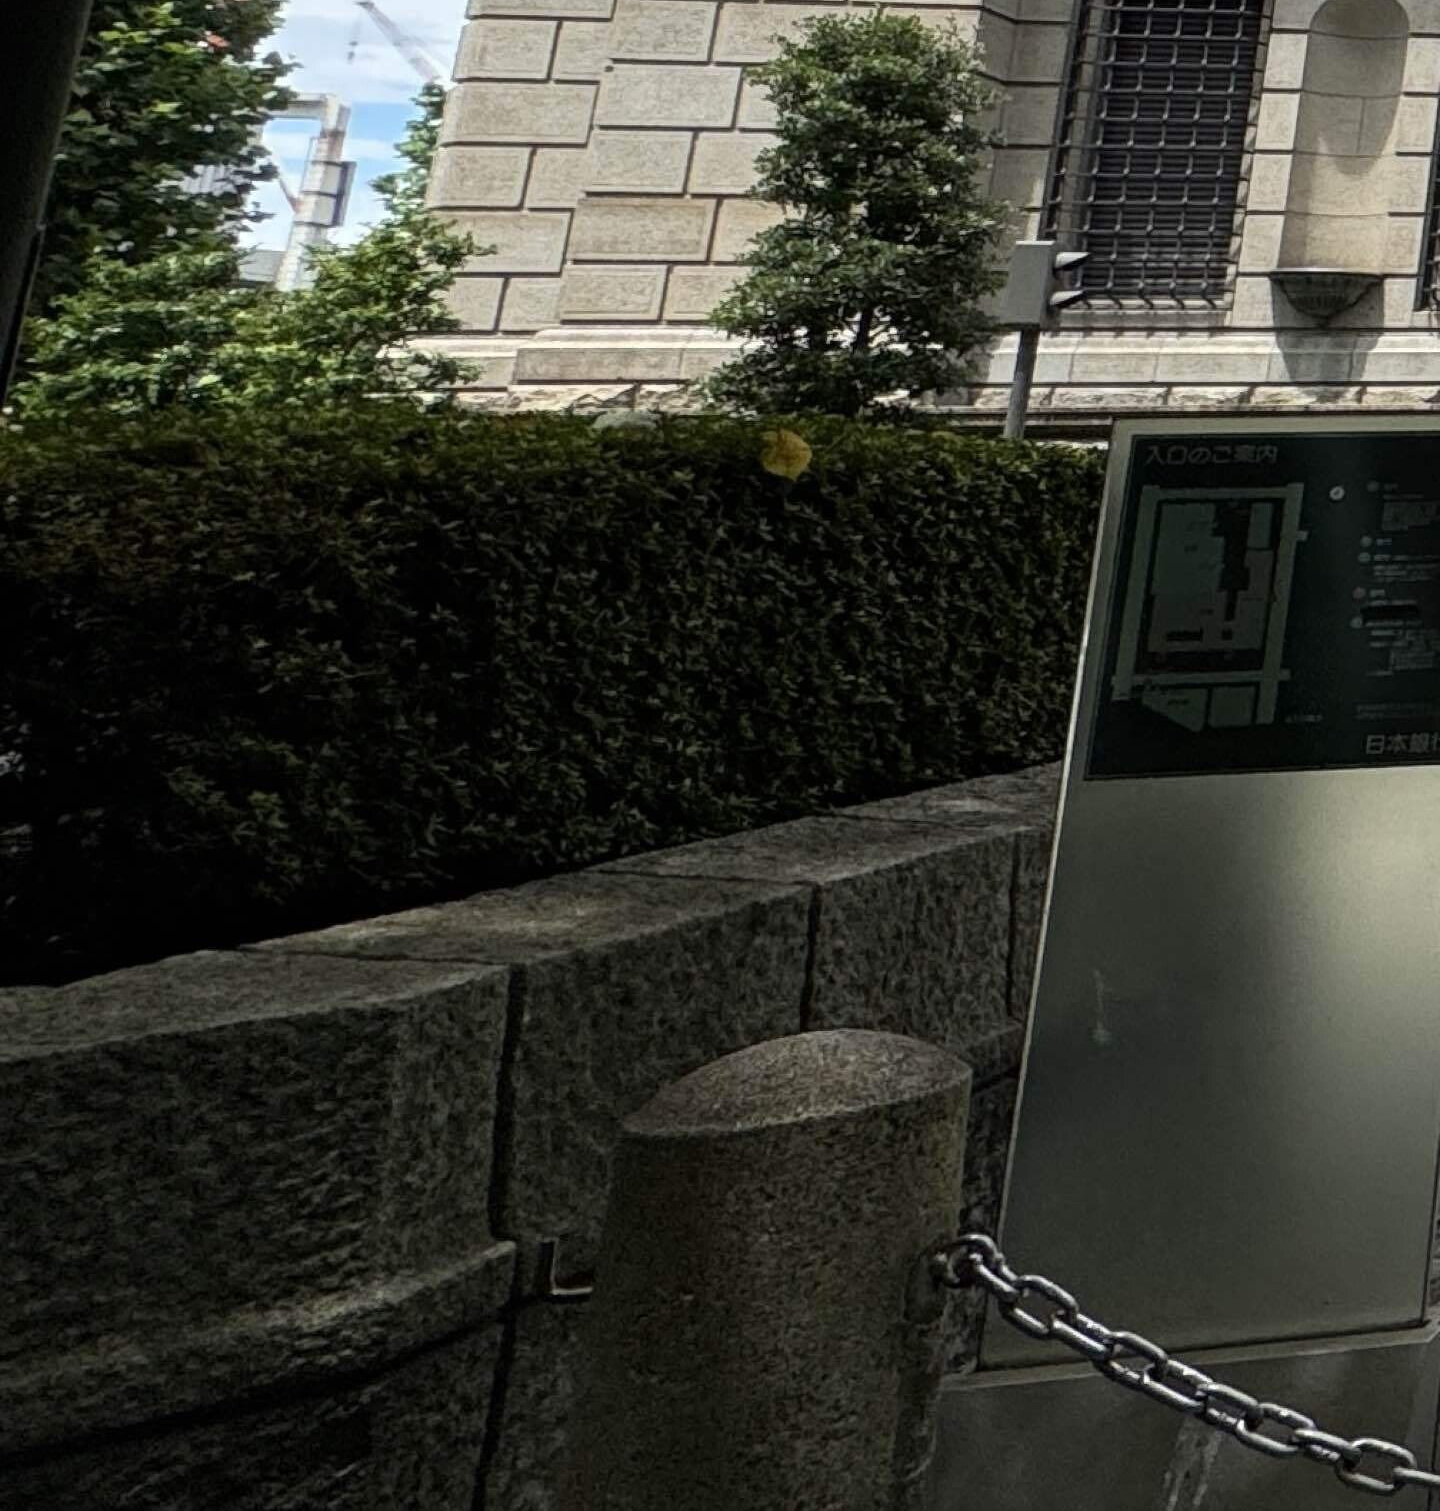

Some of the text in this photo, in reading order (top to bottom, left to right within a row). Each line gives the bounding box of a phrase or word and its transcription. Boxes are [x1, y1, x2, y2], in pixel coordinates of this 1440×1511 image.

[1144, 443, 1279, 467] 入口のご案内
